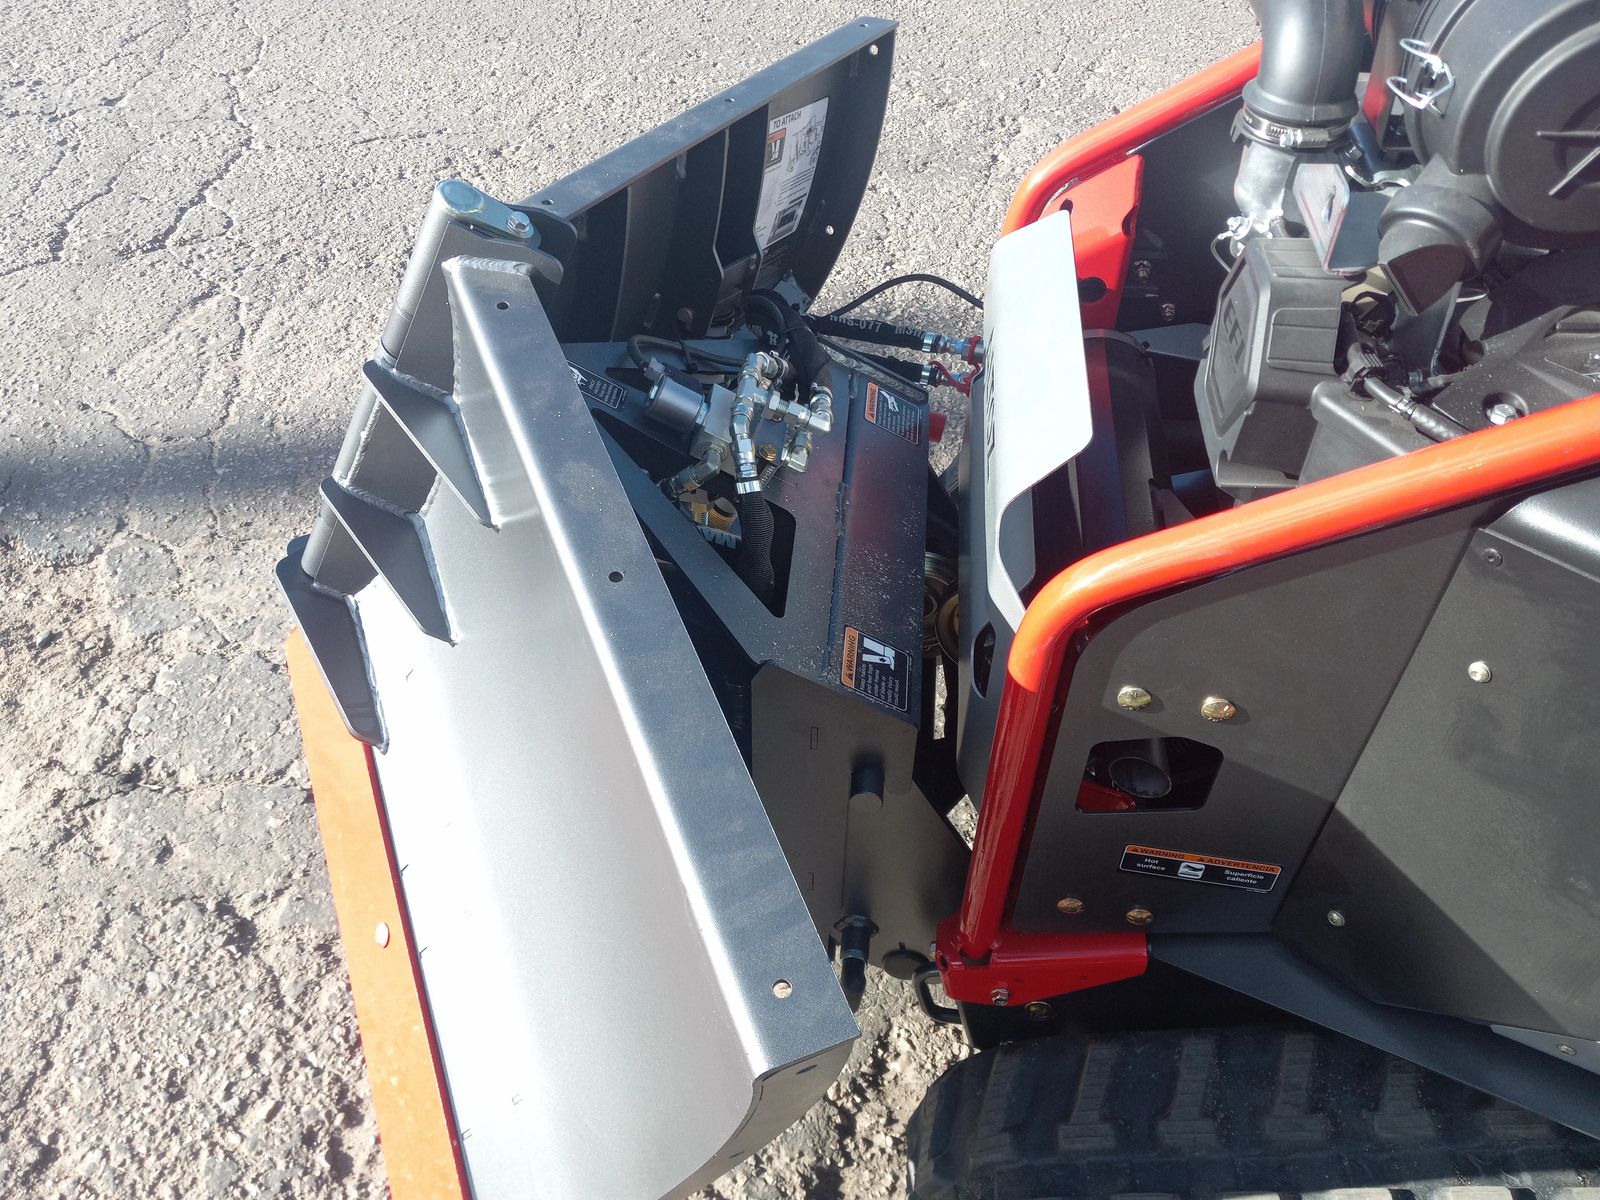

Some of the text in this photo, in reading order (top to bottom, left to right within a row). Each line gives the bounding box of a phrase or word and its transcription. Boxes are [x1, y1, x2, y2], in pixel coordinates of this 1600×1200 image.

[773, 111, 802, 130] TO ATTACH
[1223, 298, 1245, 365] EFI
[846, 635, 857, 671] WARNING
[1137, 863, 1166, 871] surface
[1140, 848, 1275, 873] WARNING ADVERTENCIA
[1224, 870, 1264, 880] Superficie
[1227, 876, 1257, 884] caliente
